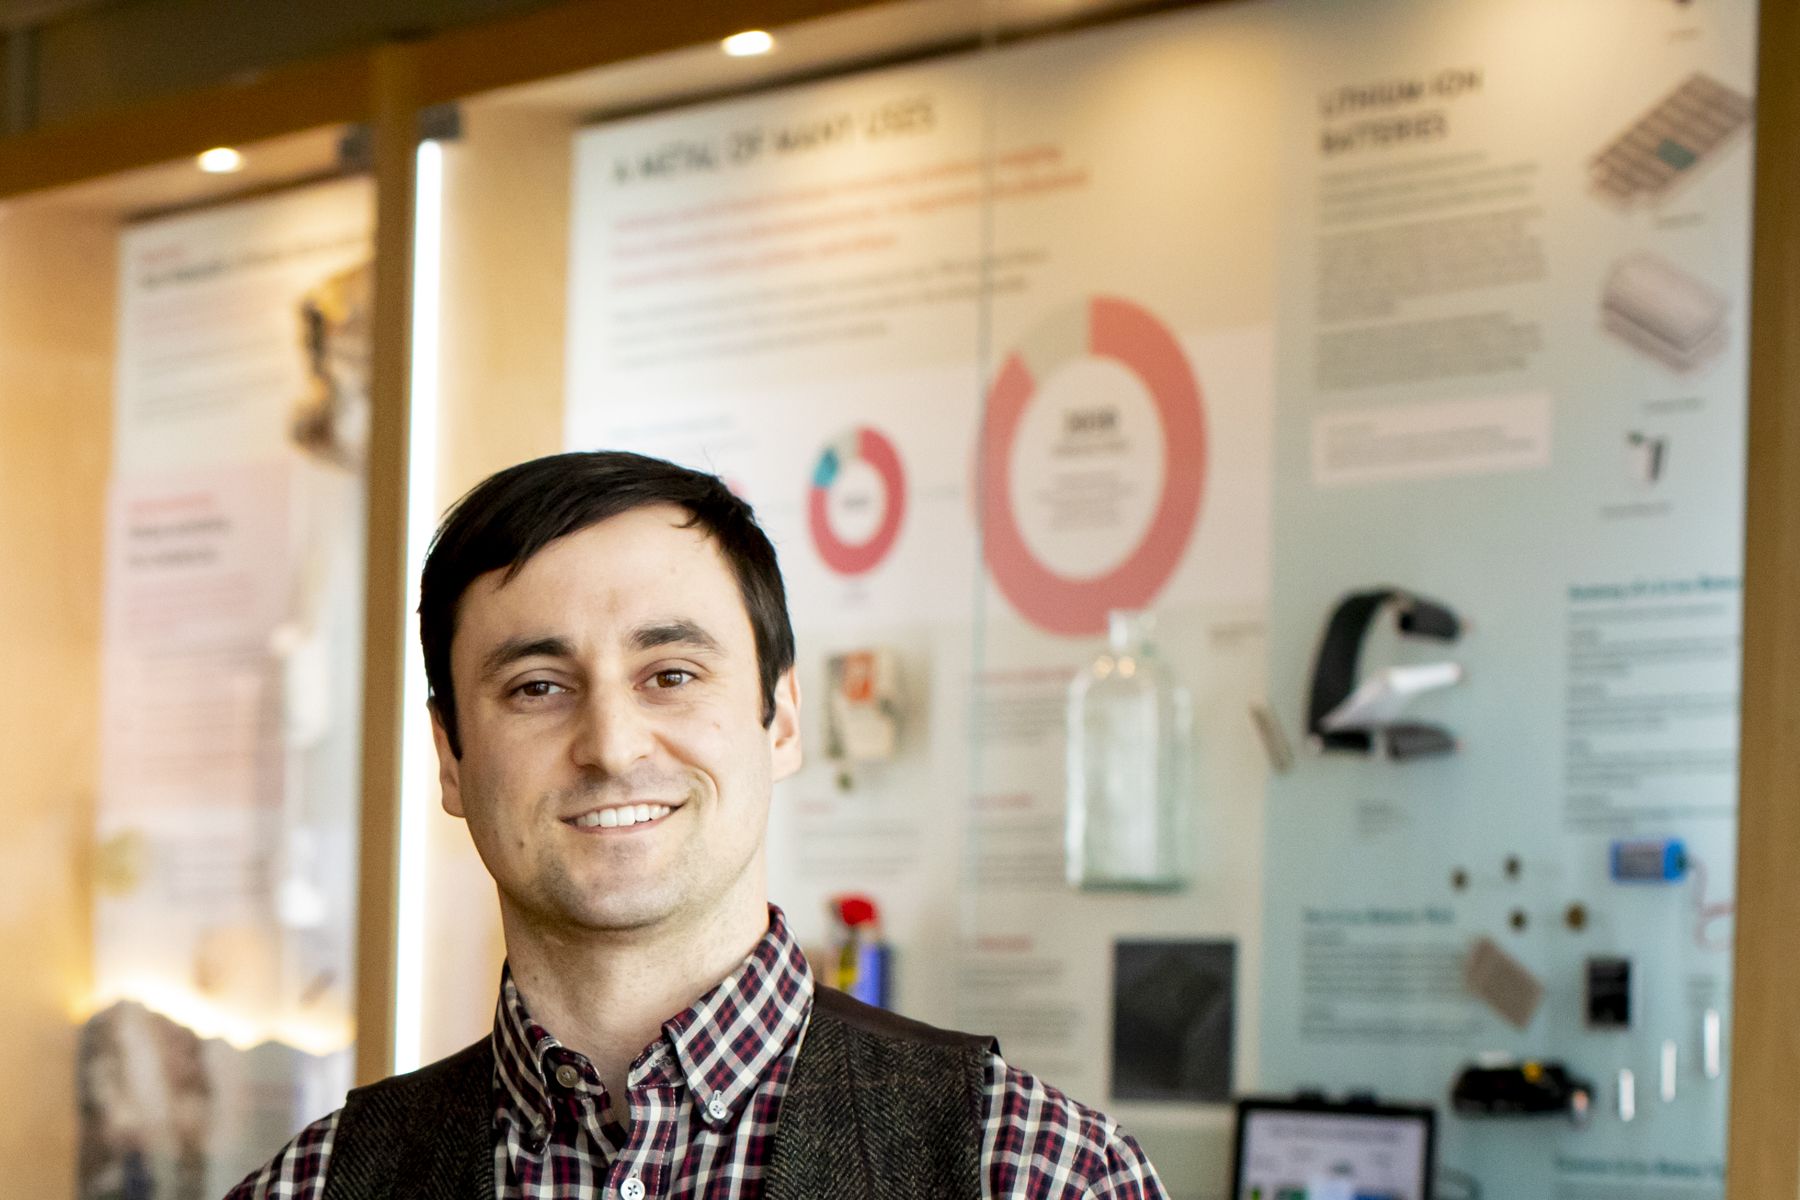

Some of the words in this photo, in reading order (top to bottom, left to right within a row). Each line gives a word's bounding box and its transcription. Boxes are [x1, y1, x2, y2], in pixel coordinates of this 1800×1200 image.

[635, 139, 716, 179] METAL
[729, 128, 763, 165] OF
[1320, 111, 1447, 155] BATTERIES
